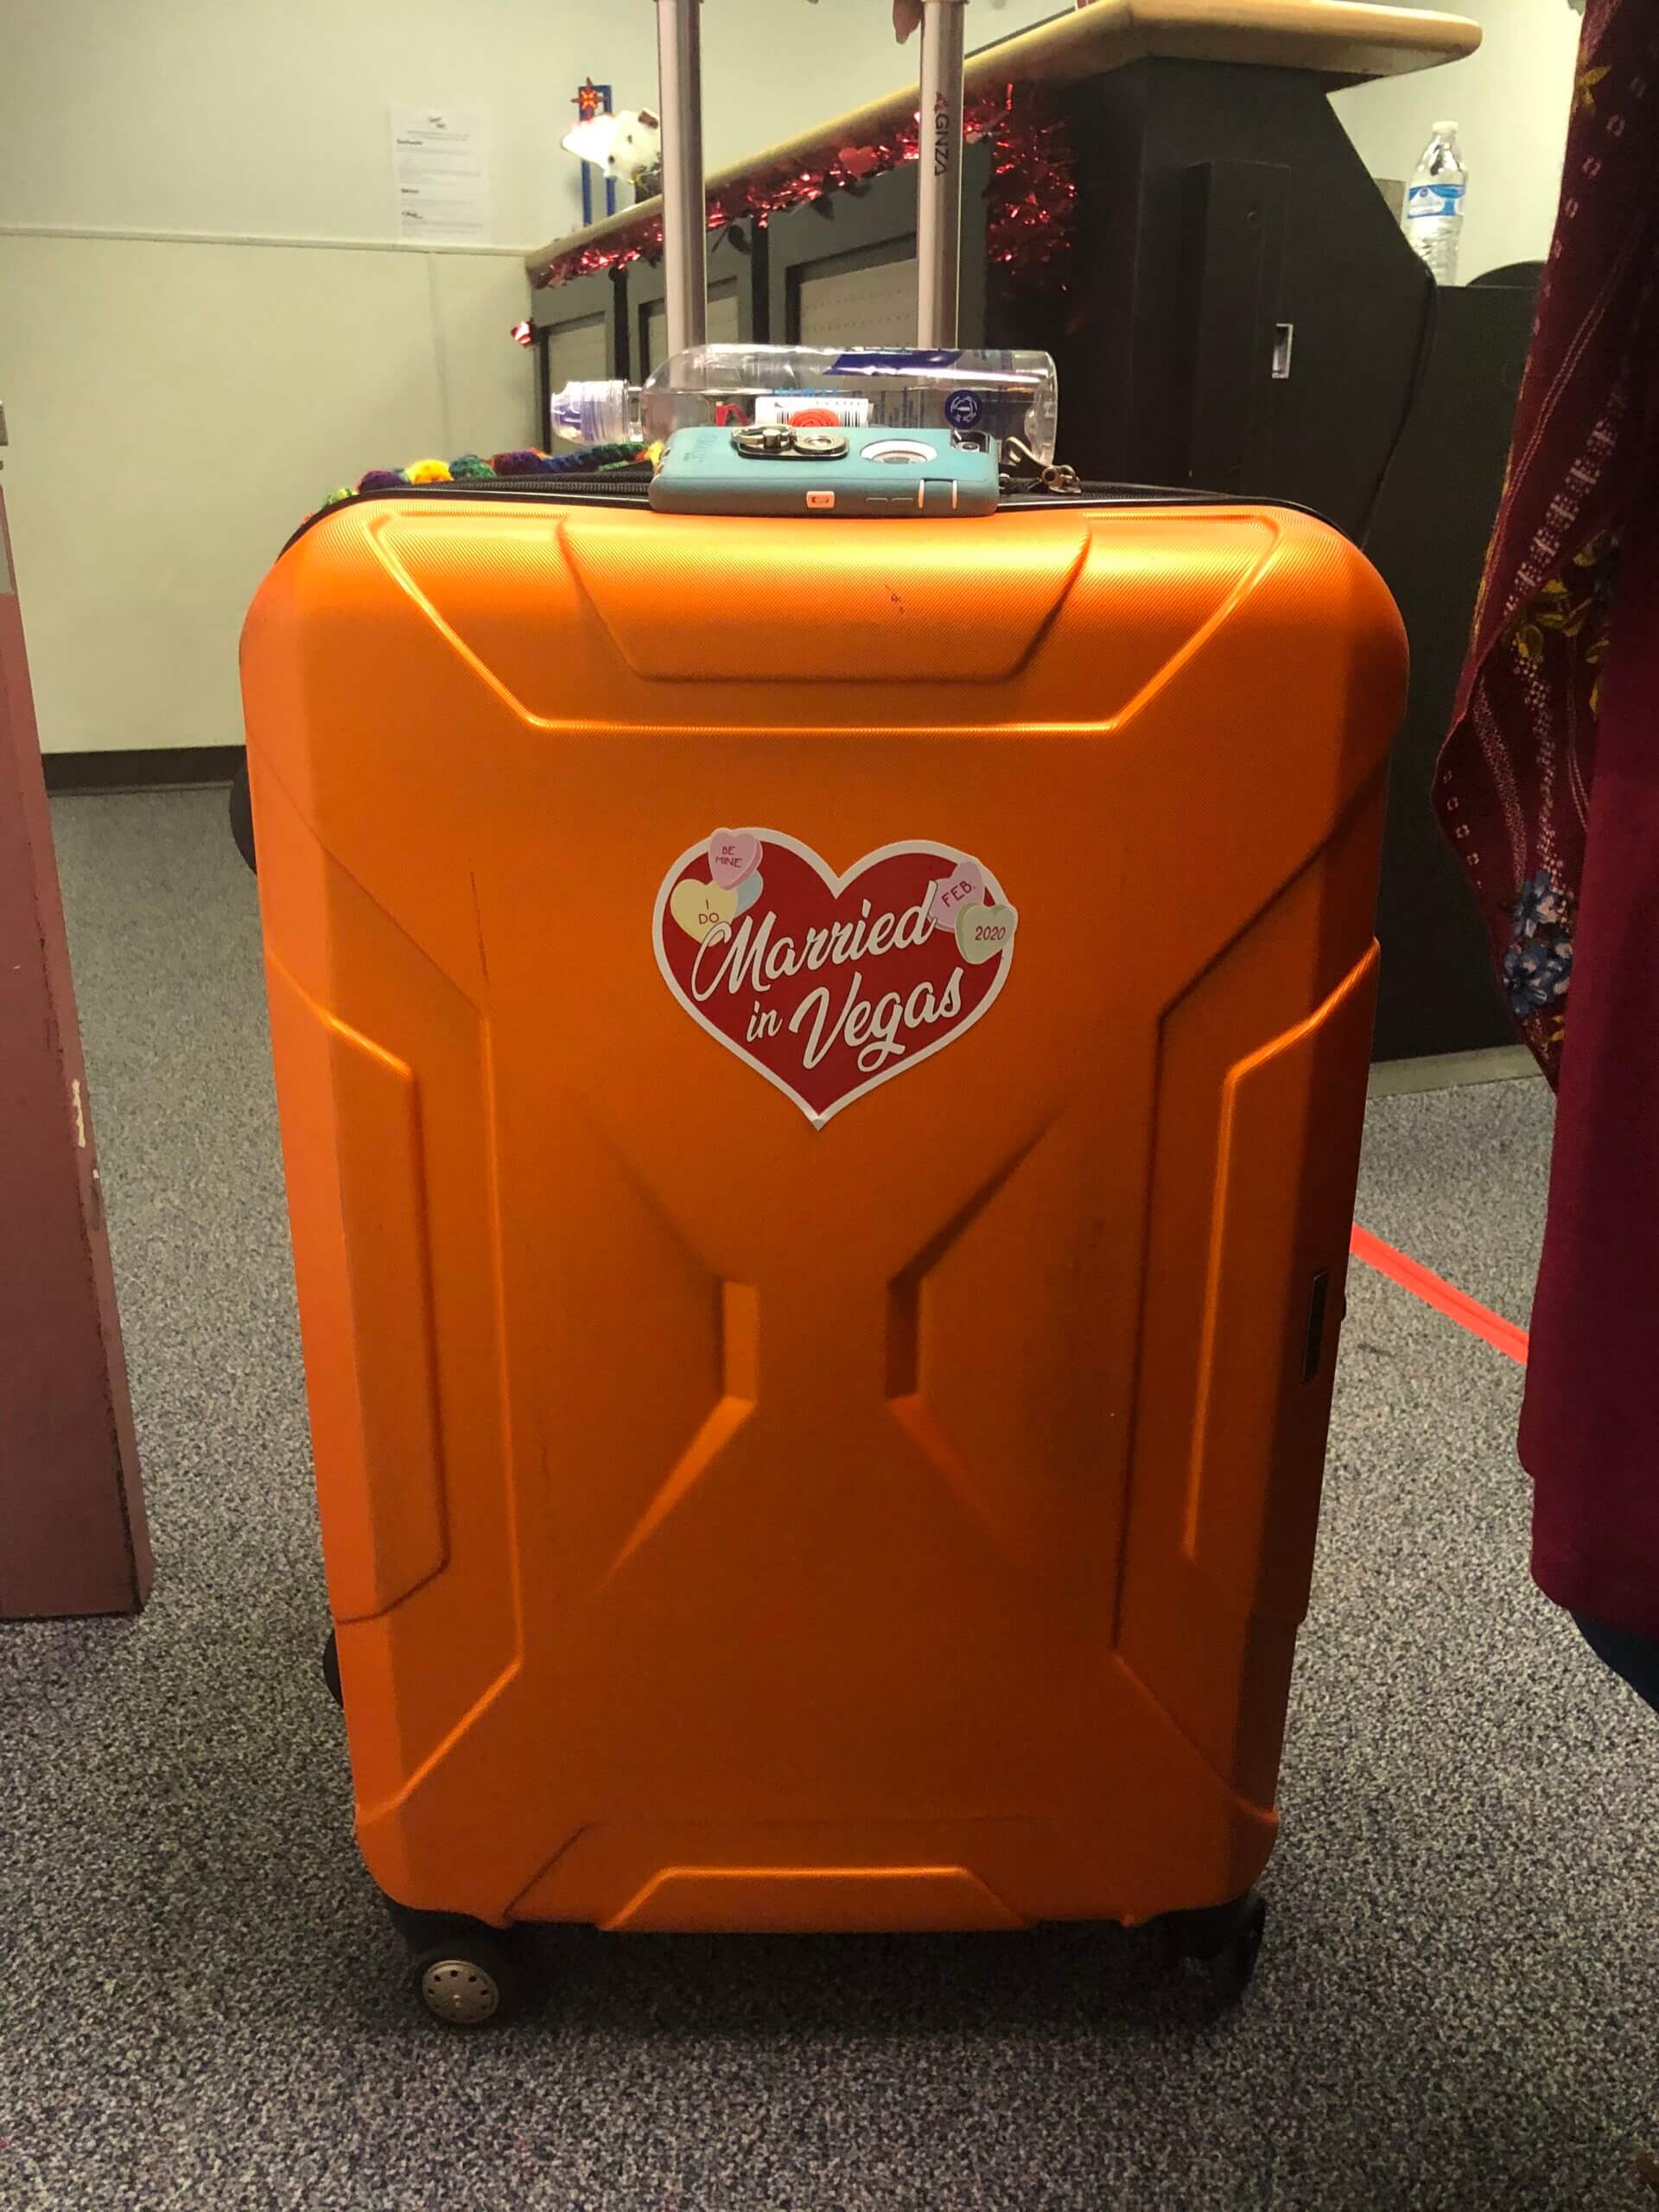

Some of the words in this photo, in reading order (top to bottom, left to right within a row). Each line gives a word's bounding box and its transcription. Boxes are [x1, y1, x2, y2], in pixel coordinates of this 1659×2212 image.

[934, 113, 949, 176] GINZA
[721, 845, 736, 855] BE
[715, 855, 743, 868] MINE
[941, 880, 976, 908] FEB.
[705, 898, 709, 910] I
[698, 912, 720, 925] DO
[691, 880, 938, 1001] Married
[974, 925, 1007, 941] 2020
[747, 1000, 783, 1043] in
[788, 966, 964, 1072] Vegas
